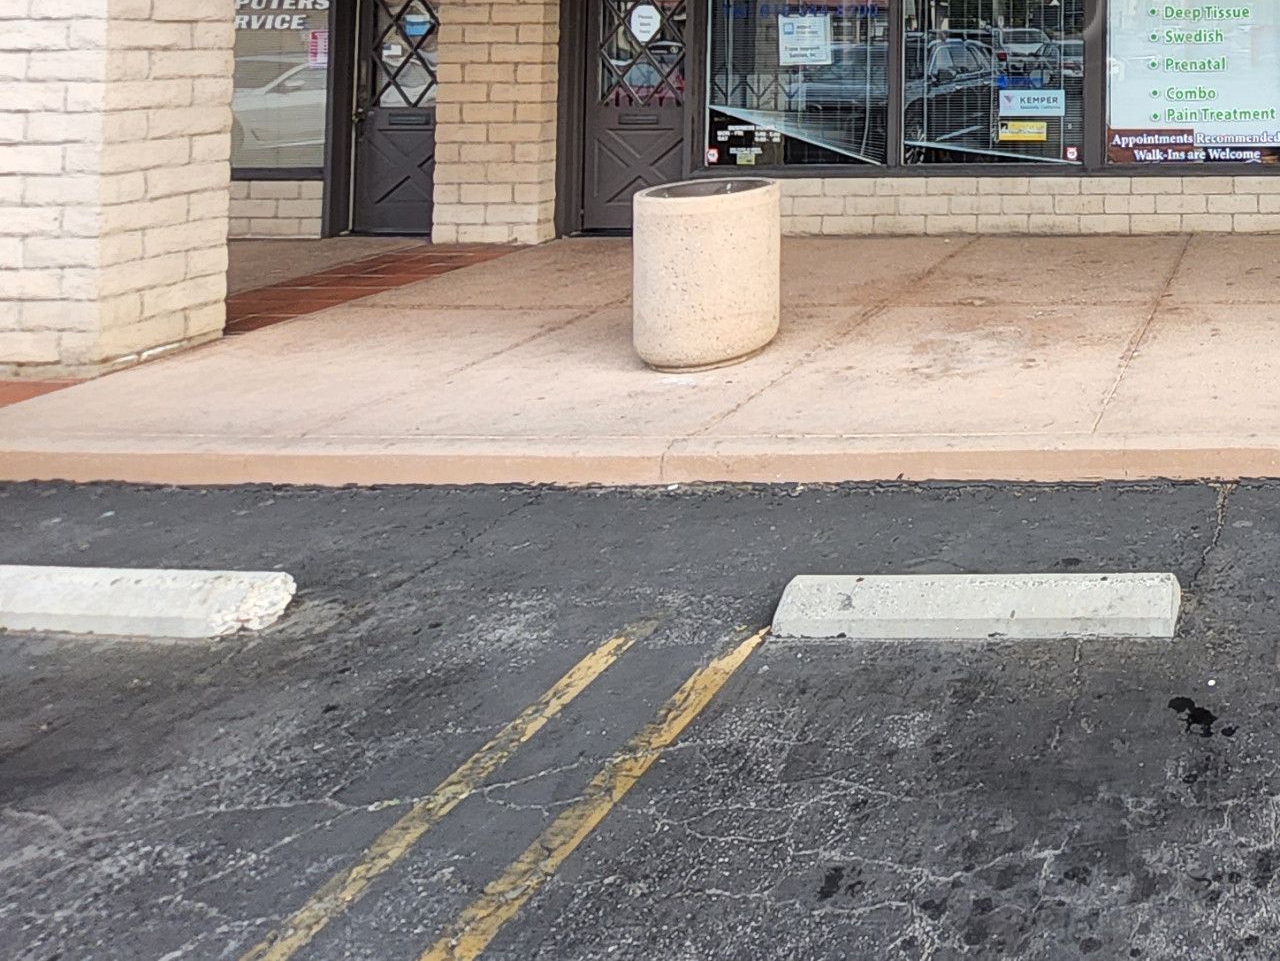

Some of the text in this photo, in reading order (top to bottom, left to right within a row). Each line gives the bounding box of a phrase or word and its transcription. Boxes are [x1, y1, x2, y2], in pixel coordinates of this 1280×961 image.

[1164, 5, 1250, 21] Deep Tissue
[1165, 29, 1224, 43] Swedish
[1165, 57, 1226, 71] Prenatal
[1166, 86, 1217, 99] Combo
[1019, 96, 1058, 105] KEMPER
[1167, 107, 1276, 121] Pain Treatment
[1111, 134, 1194, 148] Appointments
[1133, 148, 1262, 161] Walk-Ins are Welcome
